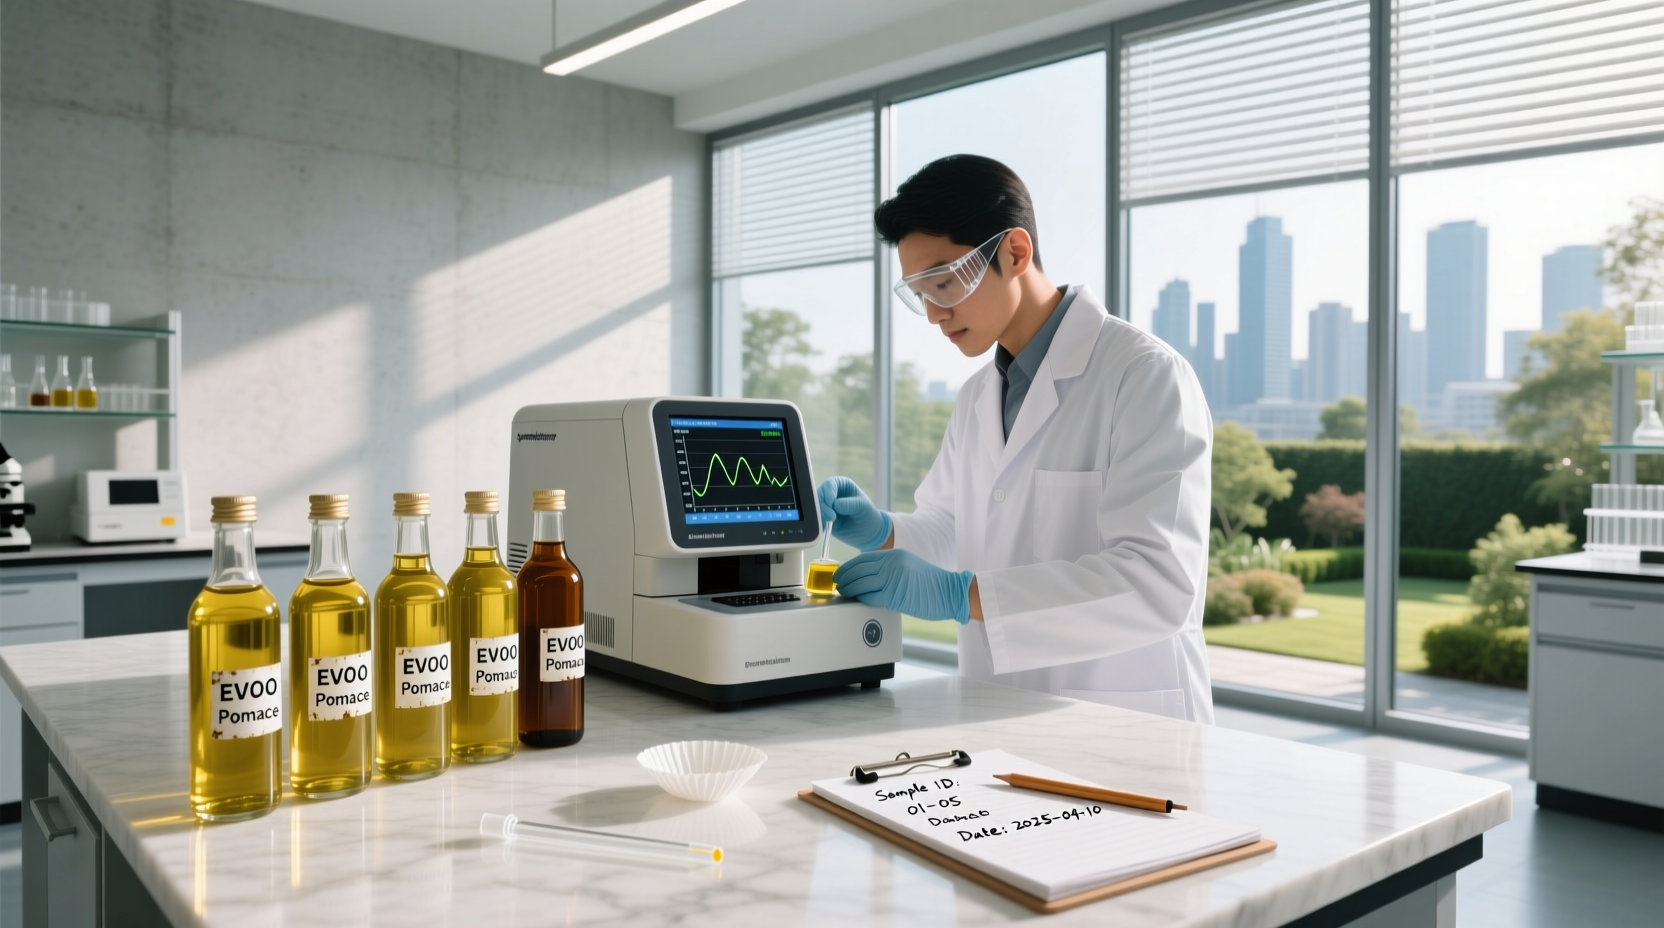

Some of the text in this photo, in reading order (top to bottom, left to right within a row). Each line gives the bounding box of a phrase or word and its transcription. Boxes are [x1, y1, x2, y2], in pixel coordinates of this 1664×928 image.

[546, 634, 584, 653] EVOO
[477, 644, 518, 664] EVOO
[403, 654, 449, 675] EVOO
[317, 664, 368, 687] EVOO
[219, 677, 278, 703] EVOO
[401, 680, 451, 696] Pomace
[315, 690, 370, 707] Pomace
[218, 706, 279, 726] Pomace
[875, 783, 928, 801] Sample
[907, 795, 961, 815] 01-05
[957, 805, 1102, 842] Date: 2025-04-10
